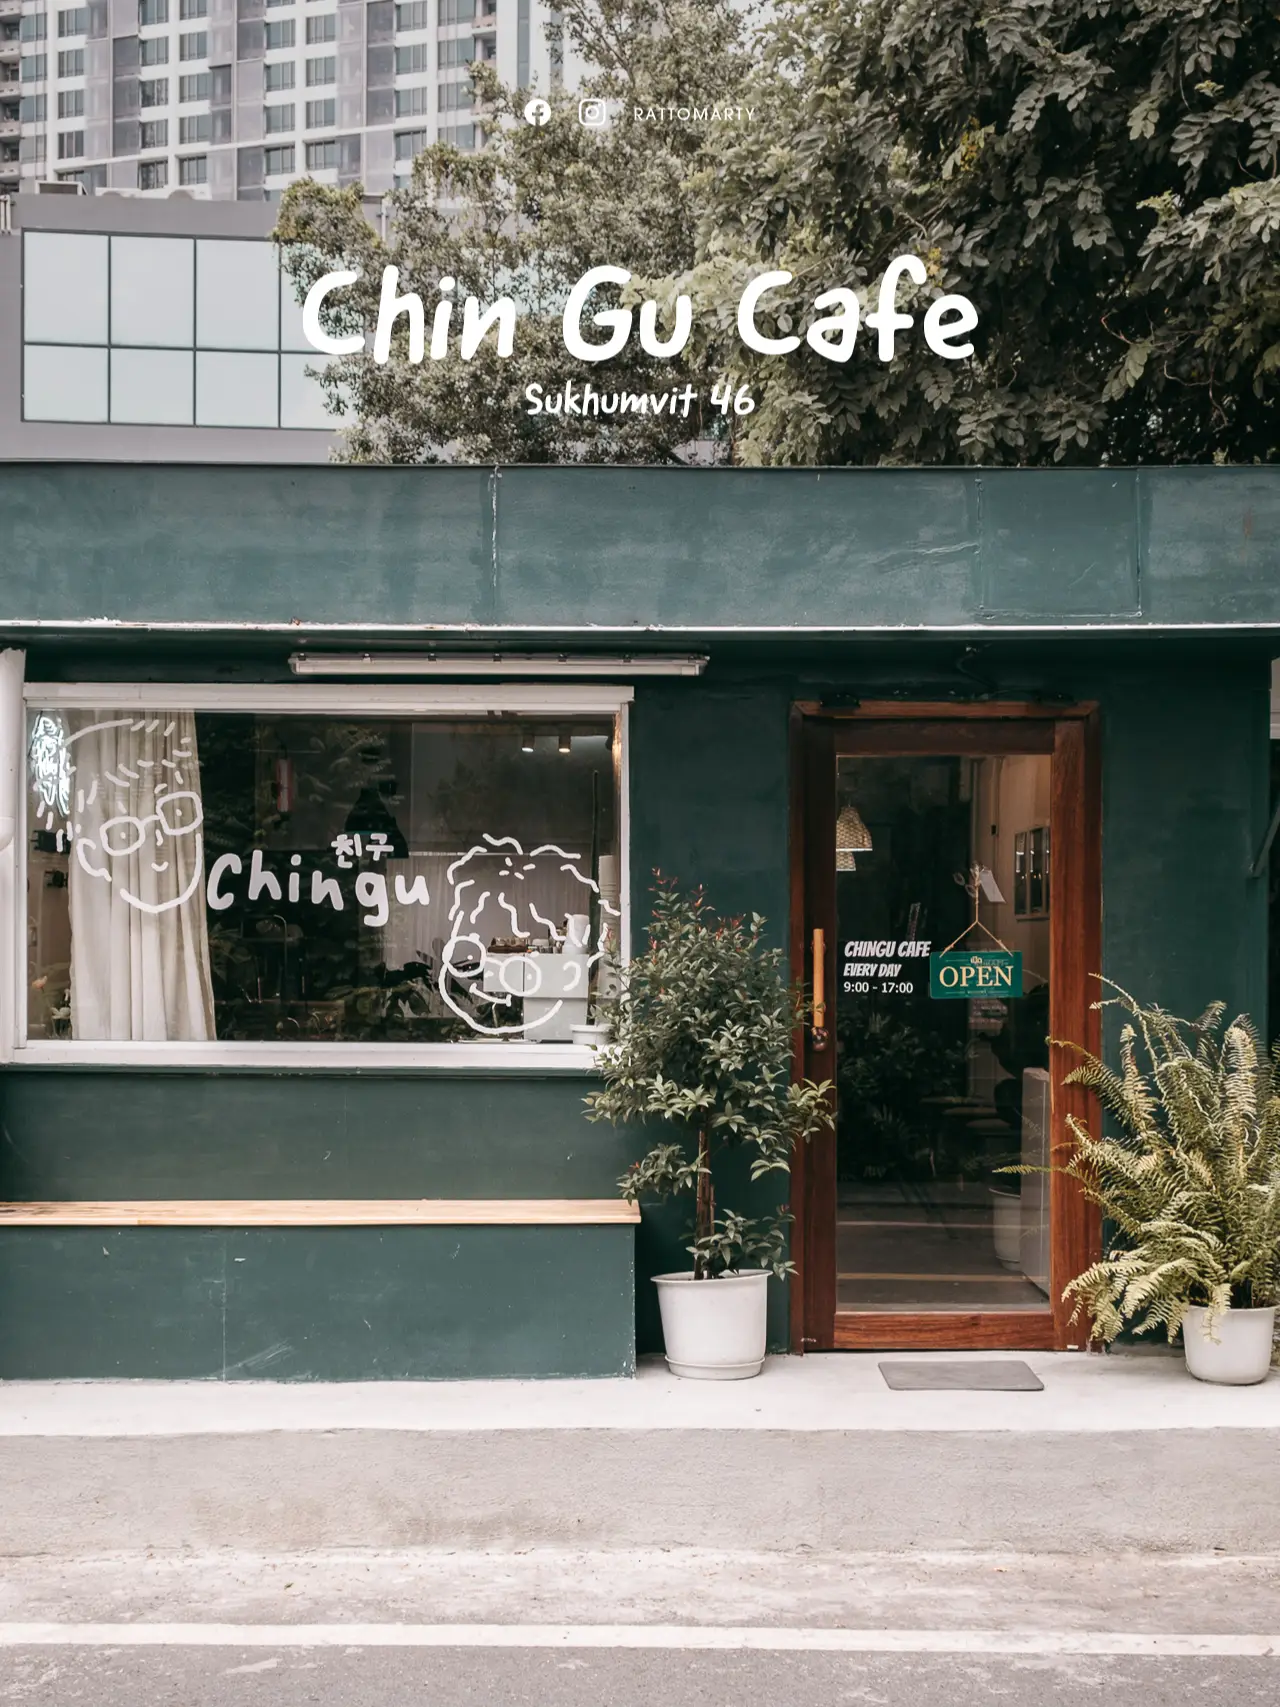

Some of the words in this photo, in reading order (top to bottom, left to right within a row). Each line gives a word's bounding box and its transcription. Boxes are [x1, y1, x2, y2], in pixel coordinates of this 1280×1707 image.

[331, 833, 394, 868] 친구
[206, 849, 430, 927] Chingu
[844, 940, 896, 958] CHINGU
[898, 940, 932, 957] CAFE
[843, 963, 877, 977] EVERY
[878, 963, 902, 977] DAY
[938, 965, 1014, 988] OPEN
[843, 981, 869, 993] 9:00
[881, 982, 914, 994] 17:00
